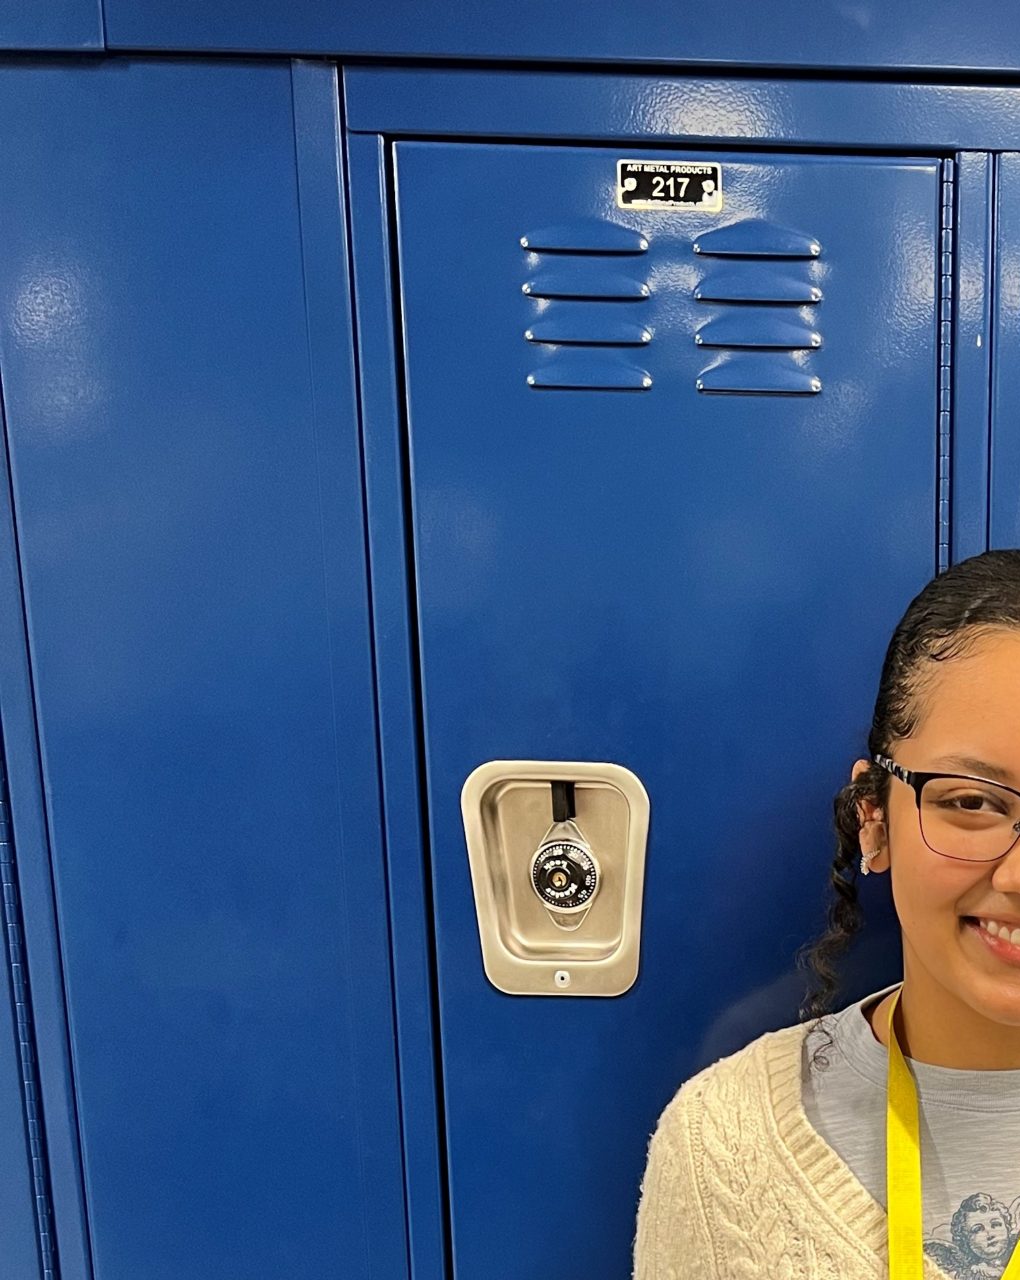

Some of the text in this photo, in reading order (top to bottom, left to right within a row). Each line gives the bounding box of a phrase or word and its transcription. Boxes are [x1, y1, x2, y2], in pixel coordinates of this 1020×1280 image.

[626, 164, 713, 175] ART METAL PRODUCTS
[651, 176, 690, 198] 217
